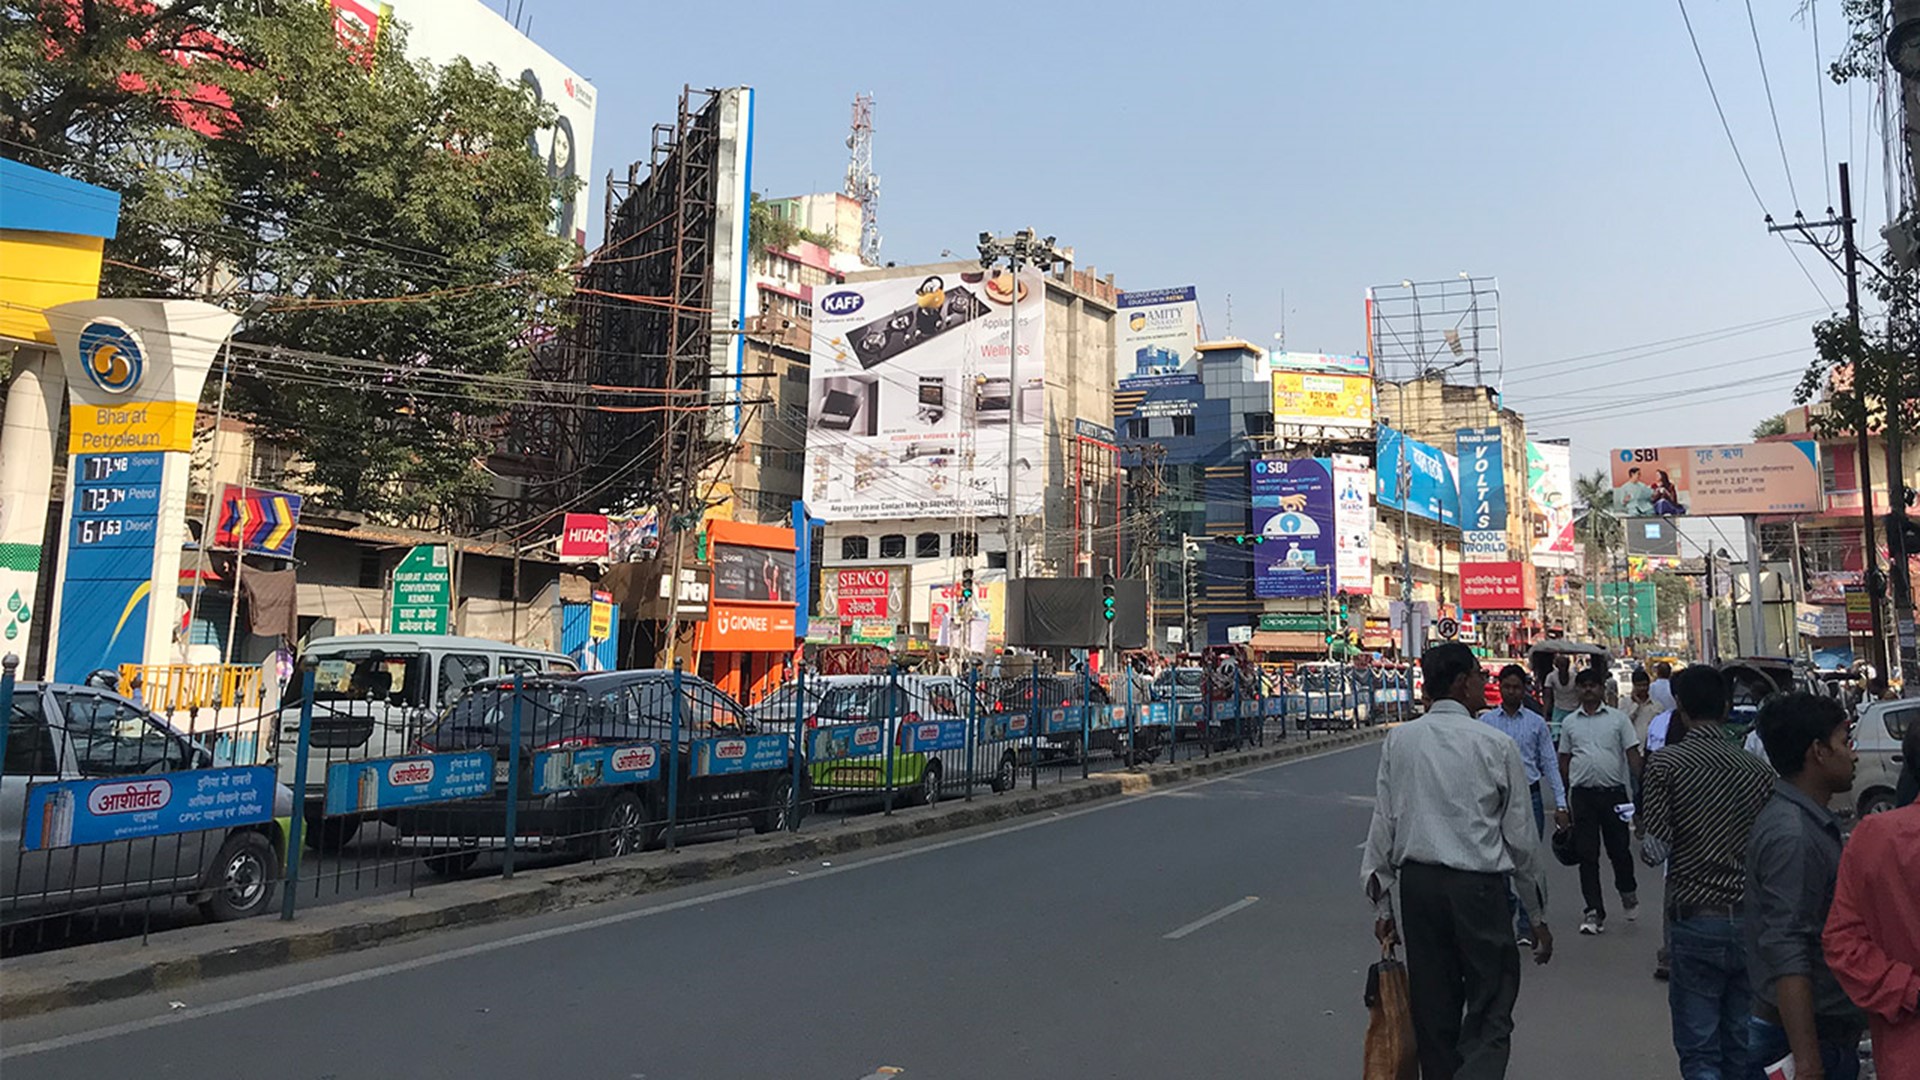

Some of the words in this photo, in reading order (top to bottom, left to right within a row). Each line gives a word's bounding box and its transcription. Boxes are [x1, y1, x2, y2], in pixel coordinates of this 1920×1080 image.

[824, 295, 861, 311] KAFF
[1147, 308, 1184, 319] AMITY
[982, 317, 1029, 330] Appliaes
[1000, 330, 1010, 341] of
[981, 344, 1030, 357] Wellnss
[96, 408, 148, 425] Bharat
[82, 431, 160, 449] Petroleum
[1459, 435, 1481, 443] BRAND
[1483, 434, 1501, 442] SHOP
[1635, 448, 1659, 463] SBI
[1696, 449, 1713, 464] गृह
[1719, 448, 1744, 459] ऋण
[92, 457, 128, 479] 77.48
[1267, 461, 1288, 474] SBI
[1474, 446, 1491, 528] VOLTAS
[88, 488, 126, 512] 73.74
[128, 488, 157, 499] Petrol
[830, 504, 842, 512] Any
[843, 504, 859, 512] query
[860, 502, 880, 511] please
[881, 501, 905, 510] Contact
[82, 520, 122, 543] 61.63
[569, 528, 609, 543] HITACH
[1469, 532, 1501, 542] COOL
[1464, 542, 1506, 552] WORLD
[396, 572, 421, 581] SAMRAT
[423, 572, 448, 581] ASHOKA
[840, 571, 886, 587] SENCO
[400, 583, 441, 592] CONVENTION
[1495, 585, 1503, 594] के
[407, 594, 435, 603] KENDRA
[730, 615, 768, 632] GIONEE
[393, 763, 430, 783] आशीर्वाद
[197, 777, 219, 792] दुनिया
[221, 772, 229, 786] में
[98, 784, 162, 811] आशीर्वाद
[179, 811, 202, 823] CPVC
